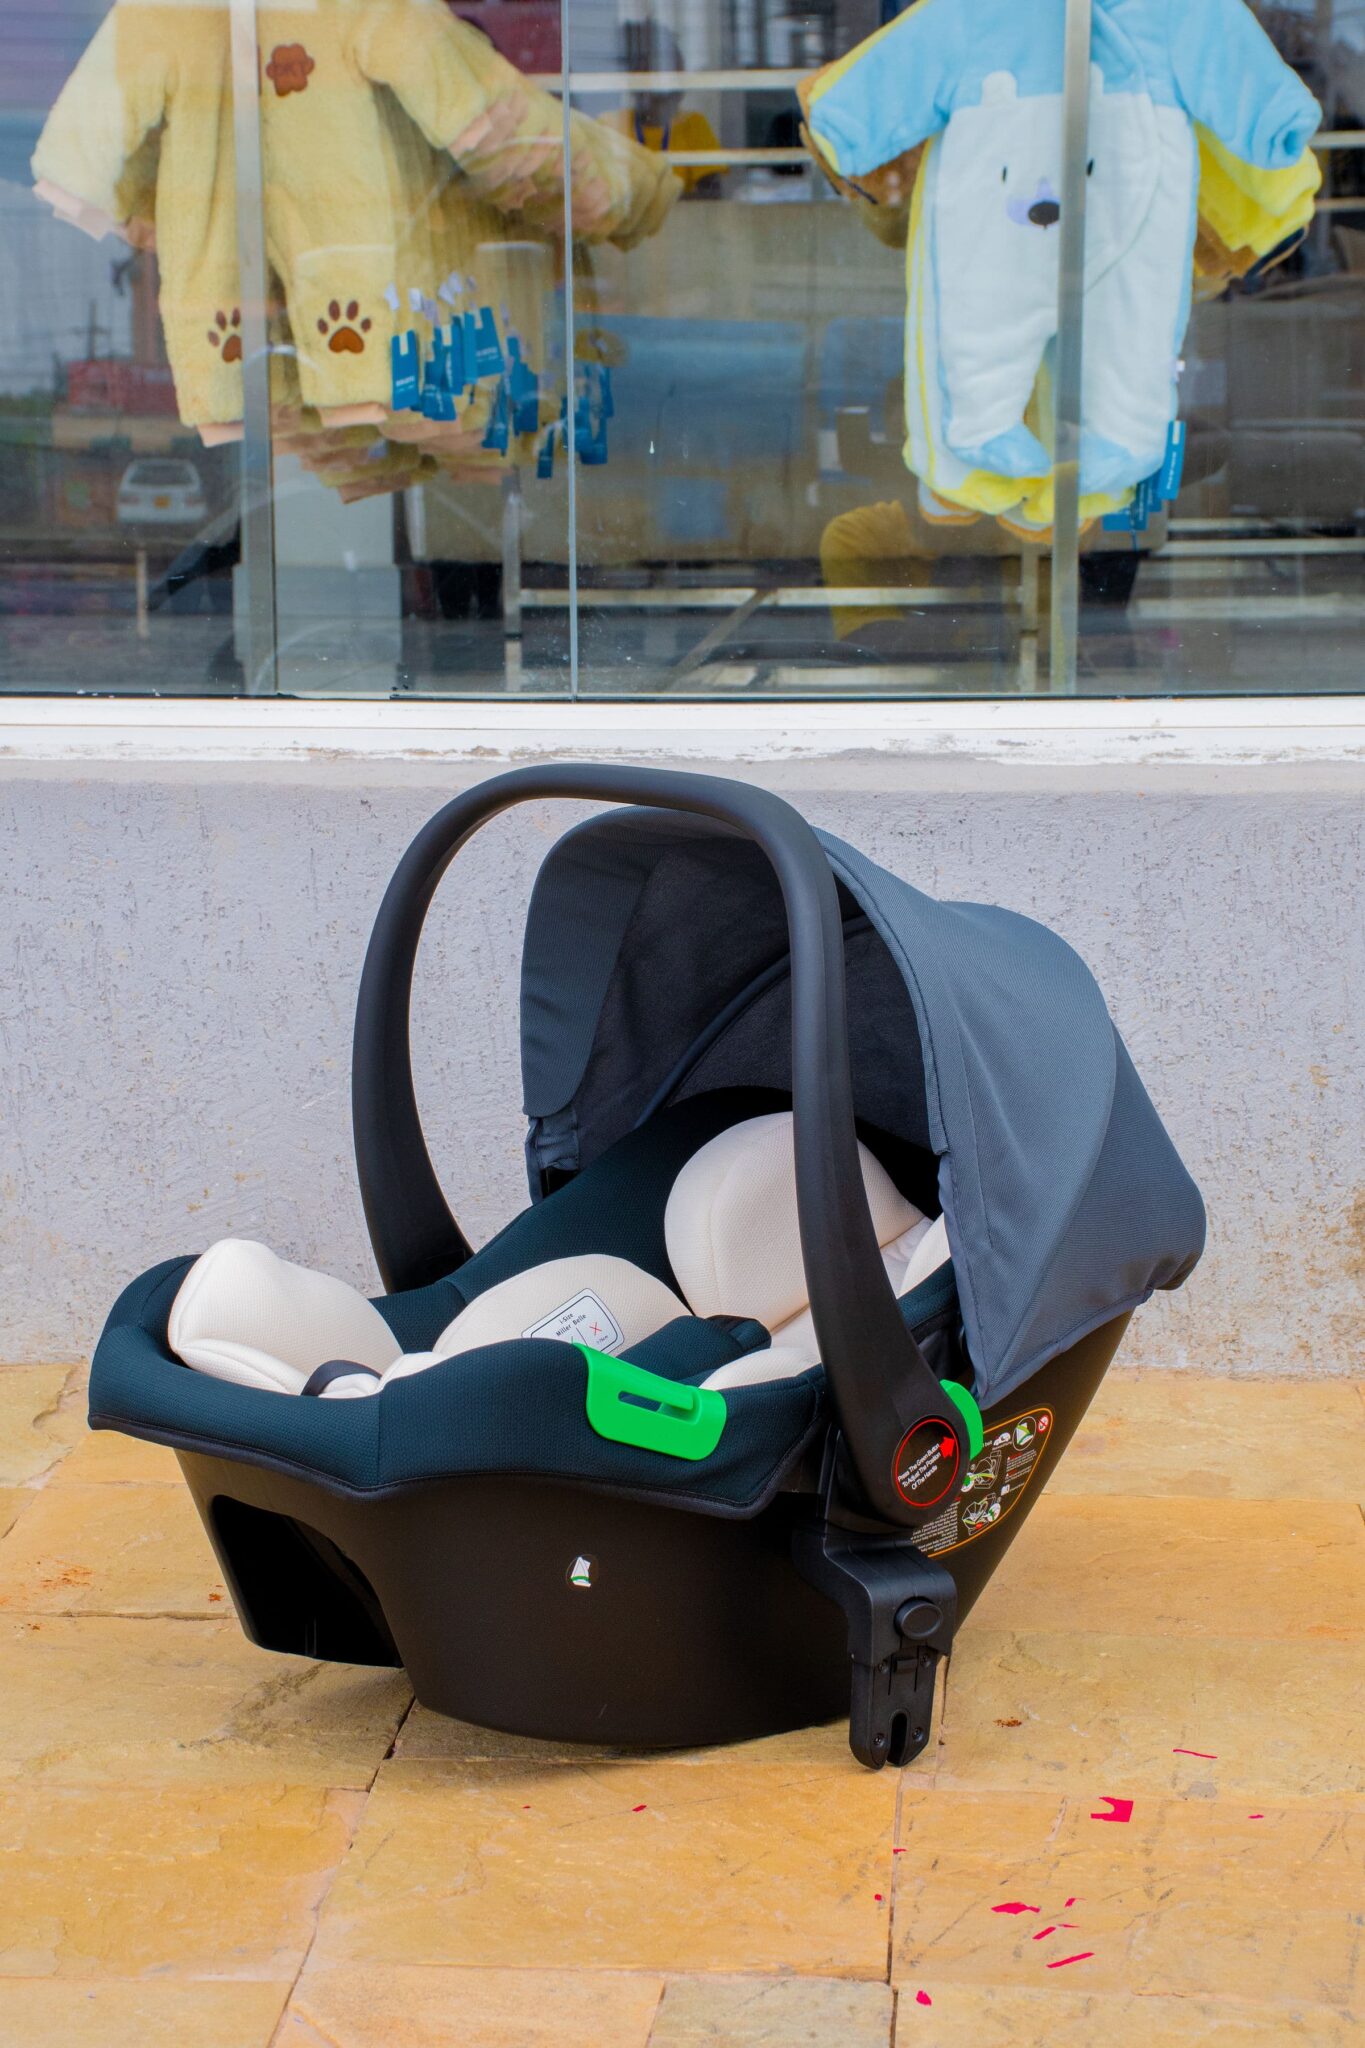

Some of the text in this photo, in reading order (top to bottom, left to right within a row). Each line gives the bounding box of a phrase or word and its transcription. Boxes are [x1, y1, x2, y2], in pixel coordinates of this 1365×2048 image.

[556, 1314, 587, 1336] Miller Belle
[898, 1443, 940, 1482] Press The Green Button
[908, 1471, 920, 1482] Adjust
[919, 1465, 927, 1473] The
[926, 1452, 941, 1467] Position
[917, 1477, 925, 1485] The
[924, 1465, 938, 1479] Handle
